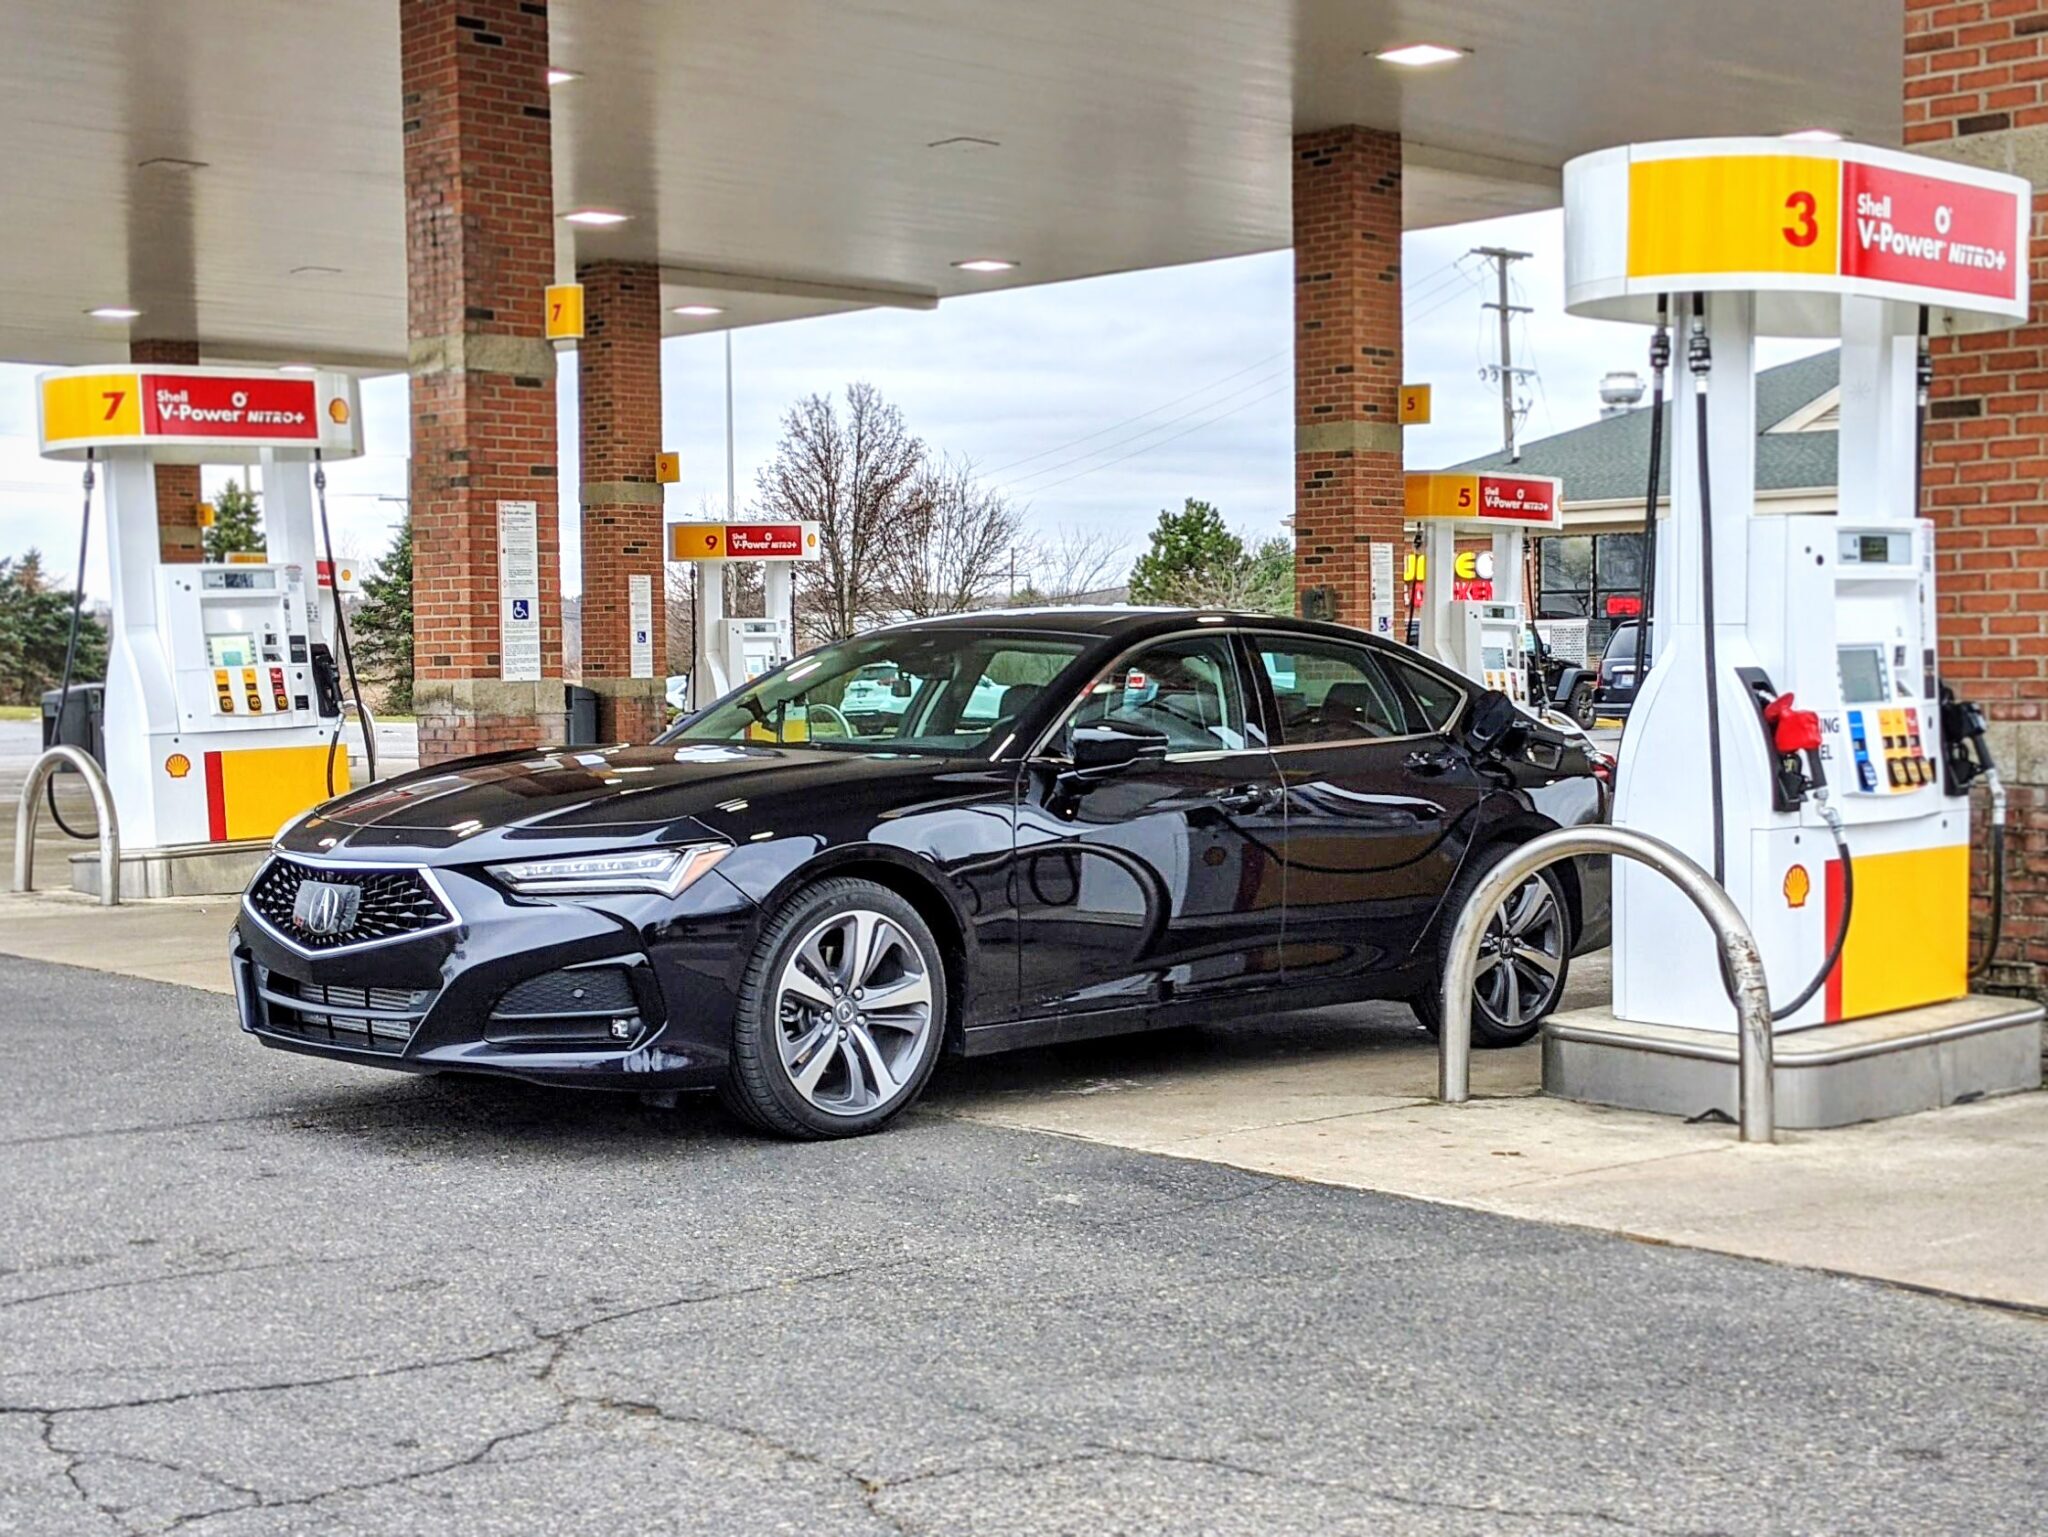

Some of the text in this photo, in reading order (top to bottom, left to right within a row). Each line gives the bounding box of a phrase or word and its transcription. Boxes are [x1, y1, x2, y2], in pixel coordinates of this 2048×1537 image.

[1857, 193, 1892, 219] Shell
[1782, 190, 1818, 247] 3
[1857, 217, 1943, 261] V-Power
[552, 303, 562, 323] 7
[157, 389, 188, 403] Shell
[1406, 396, 1415, 411] 5
[102, 392, 126, 421] 7
[157, 403, 240, 422] V-Power
[661, 462, 668, 473] 9
[1458, 487, 1471, 508] 5
[705, 535, 718, 550] 9
[732, 532, 747, 540] Shell
[732, 540, 771, 550] V-Power
